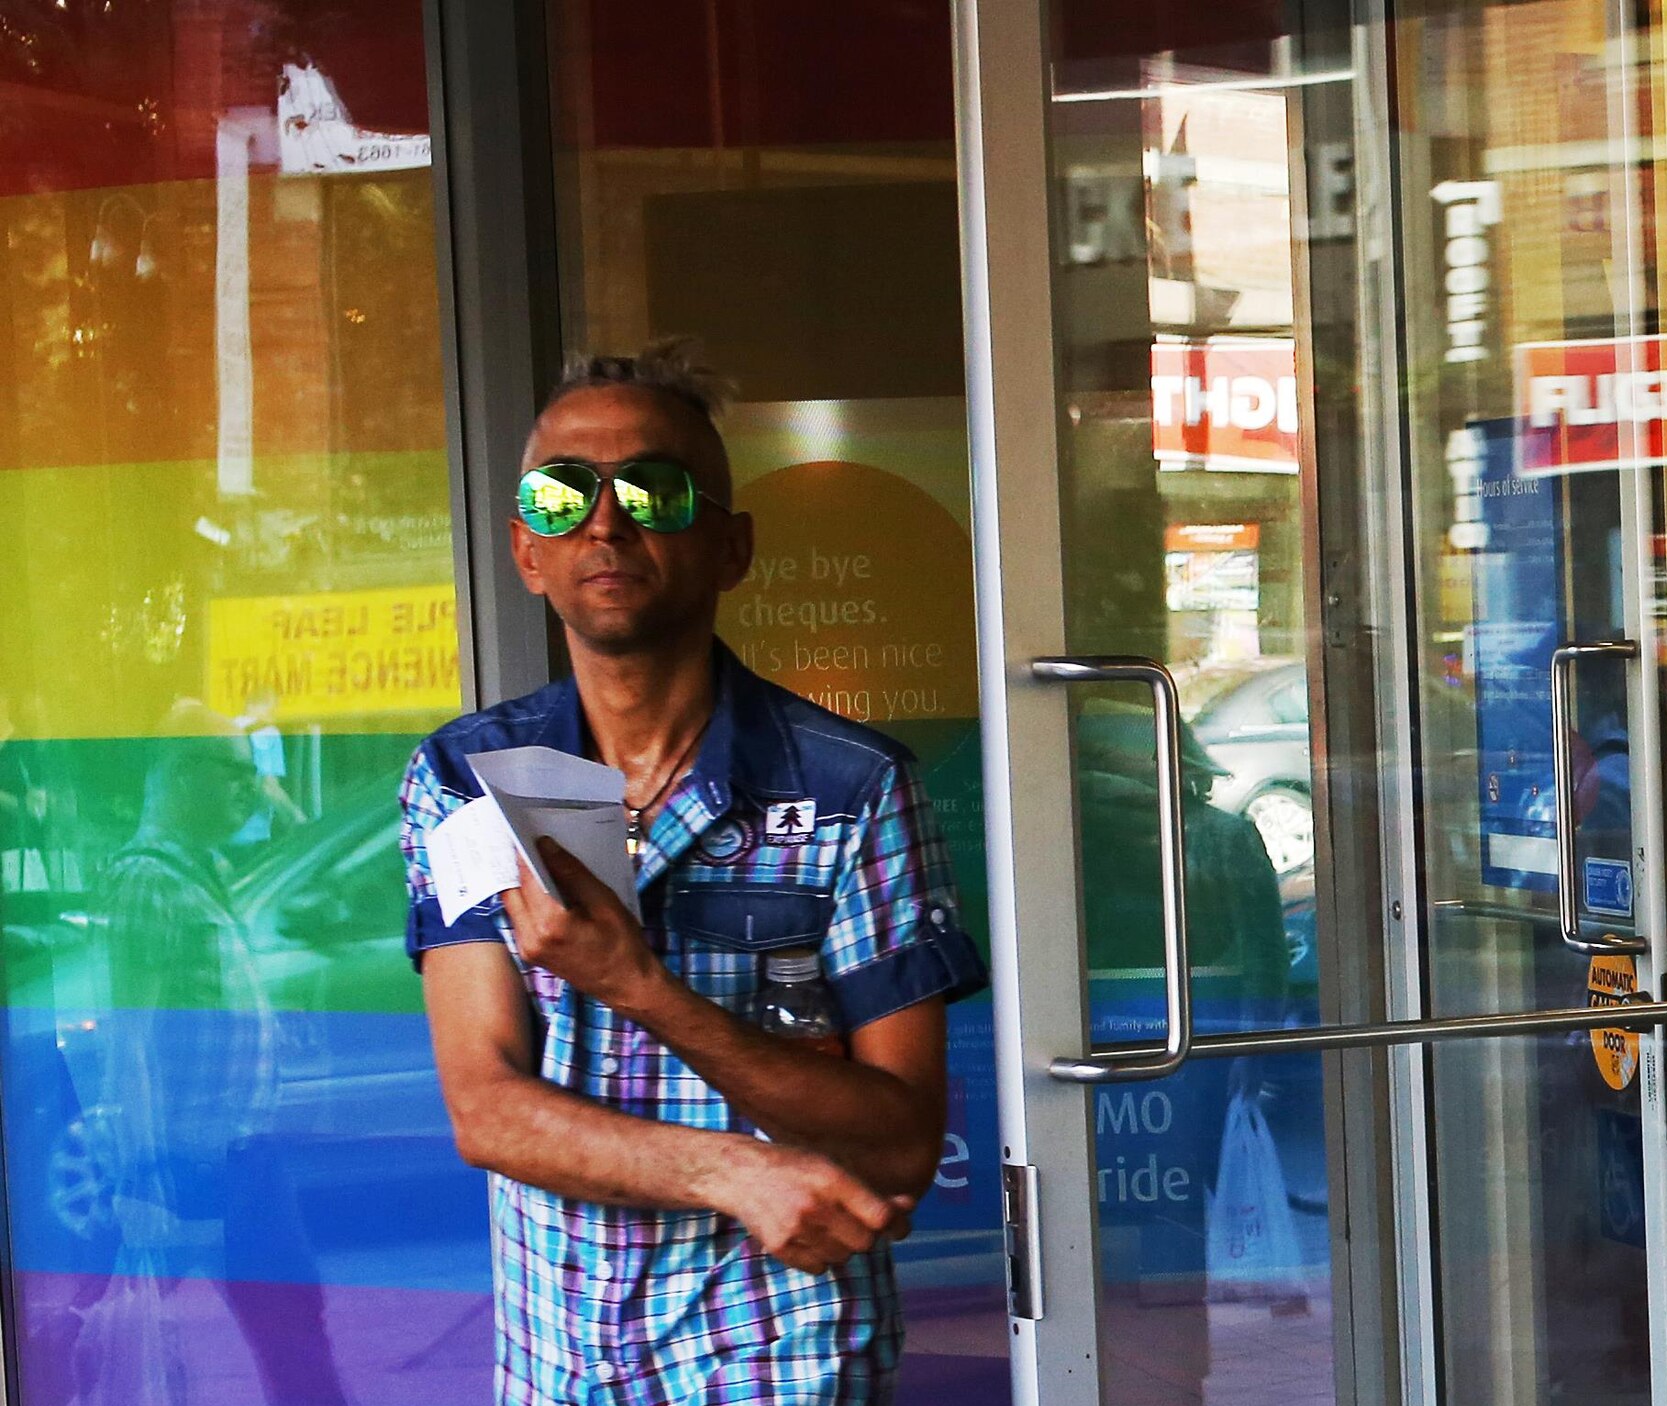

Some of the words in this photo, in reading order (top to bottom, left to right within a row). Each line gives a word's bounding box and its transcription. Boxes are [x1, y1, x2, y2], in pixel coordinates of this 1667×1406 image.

[1476, 479, 1500, 498] Hours
[1502, 475, 1511, 496] of
[1512, 476, 1539, 496] service
[811, 546, 871, 588] bye
[738, 594, 888, 633] cheques.
[794, 639, 868, 672] been
[880, 640, 942, 667] nice
[883, 688, 946, 722] you.
[1592, 966, 1634, 993] AUTOMATIC
[1603, 1030, 1626, 1054] DOOR
